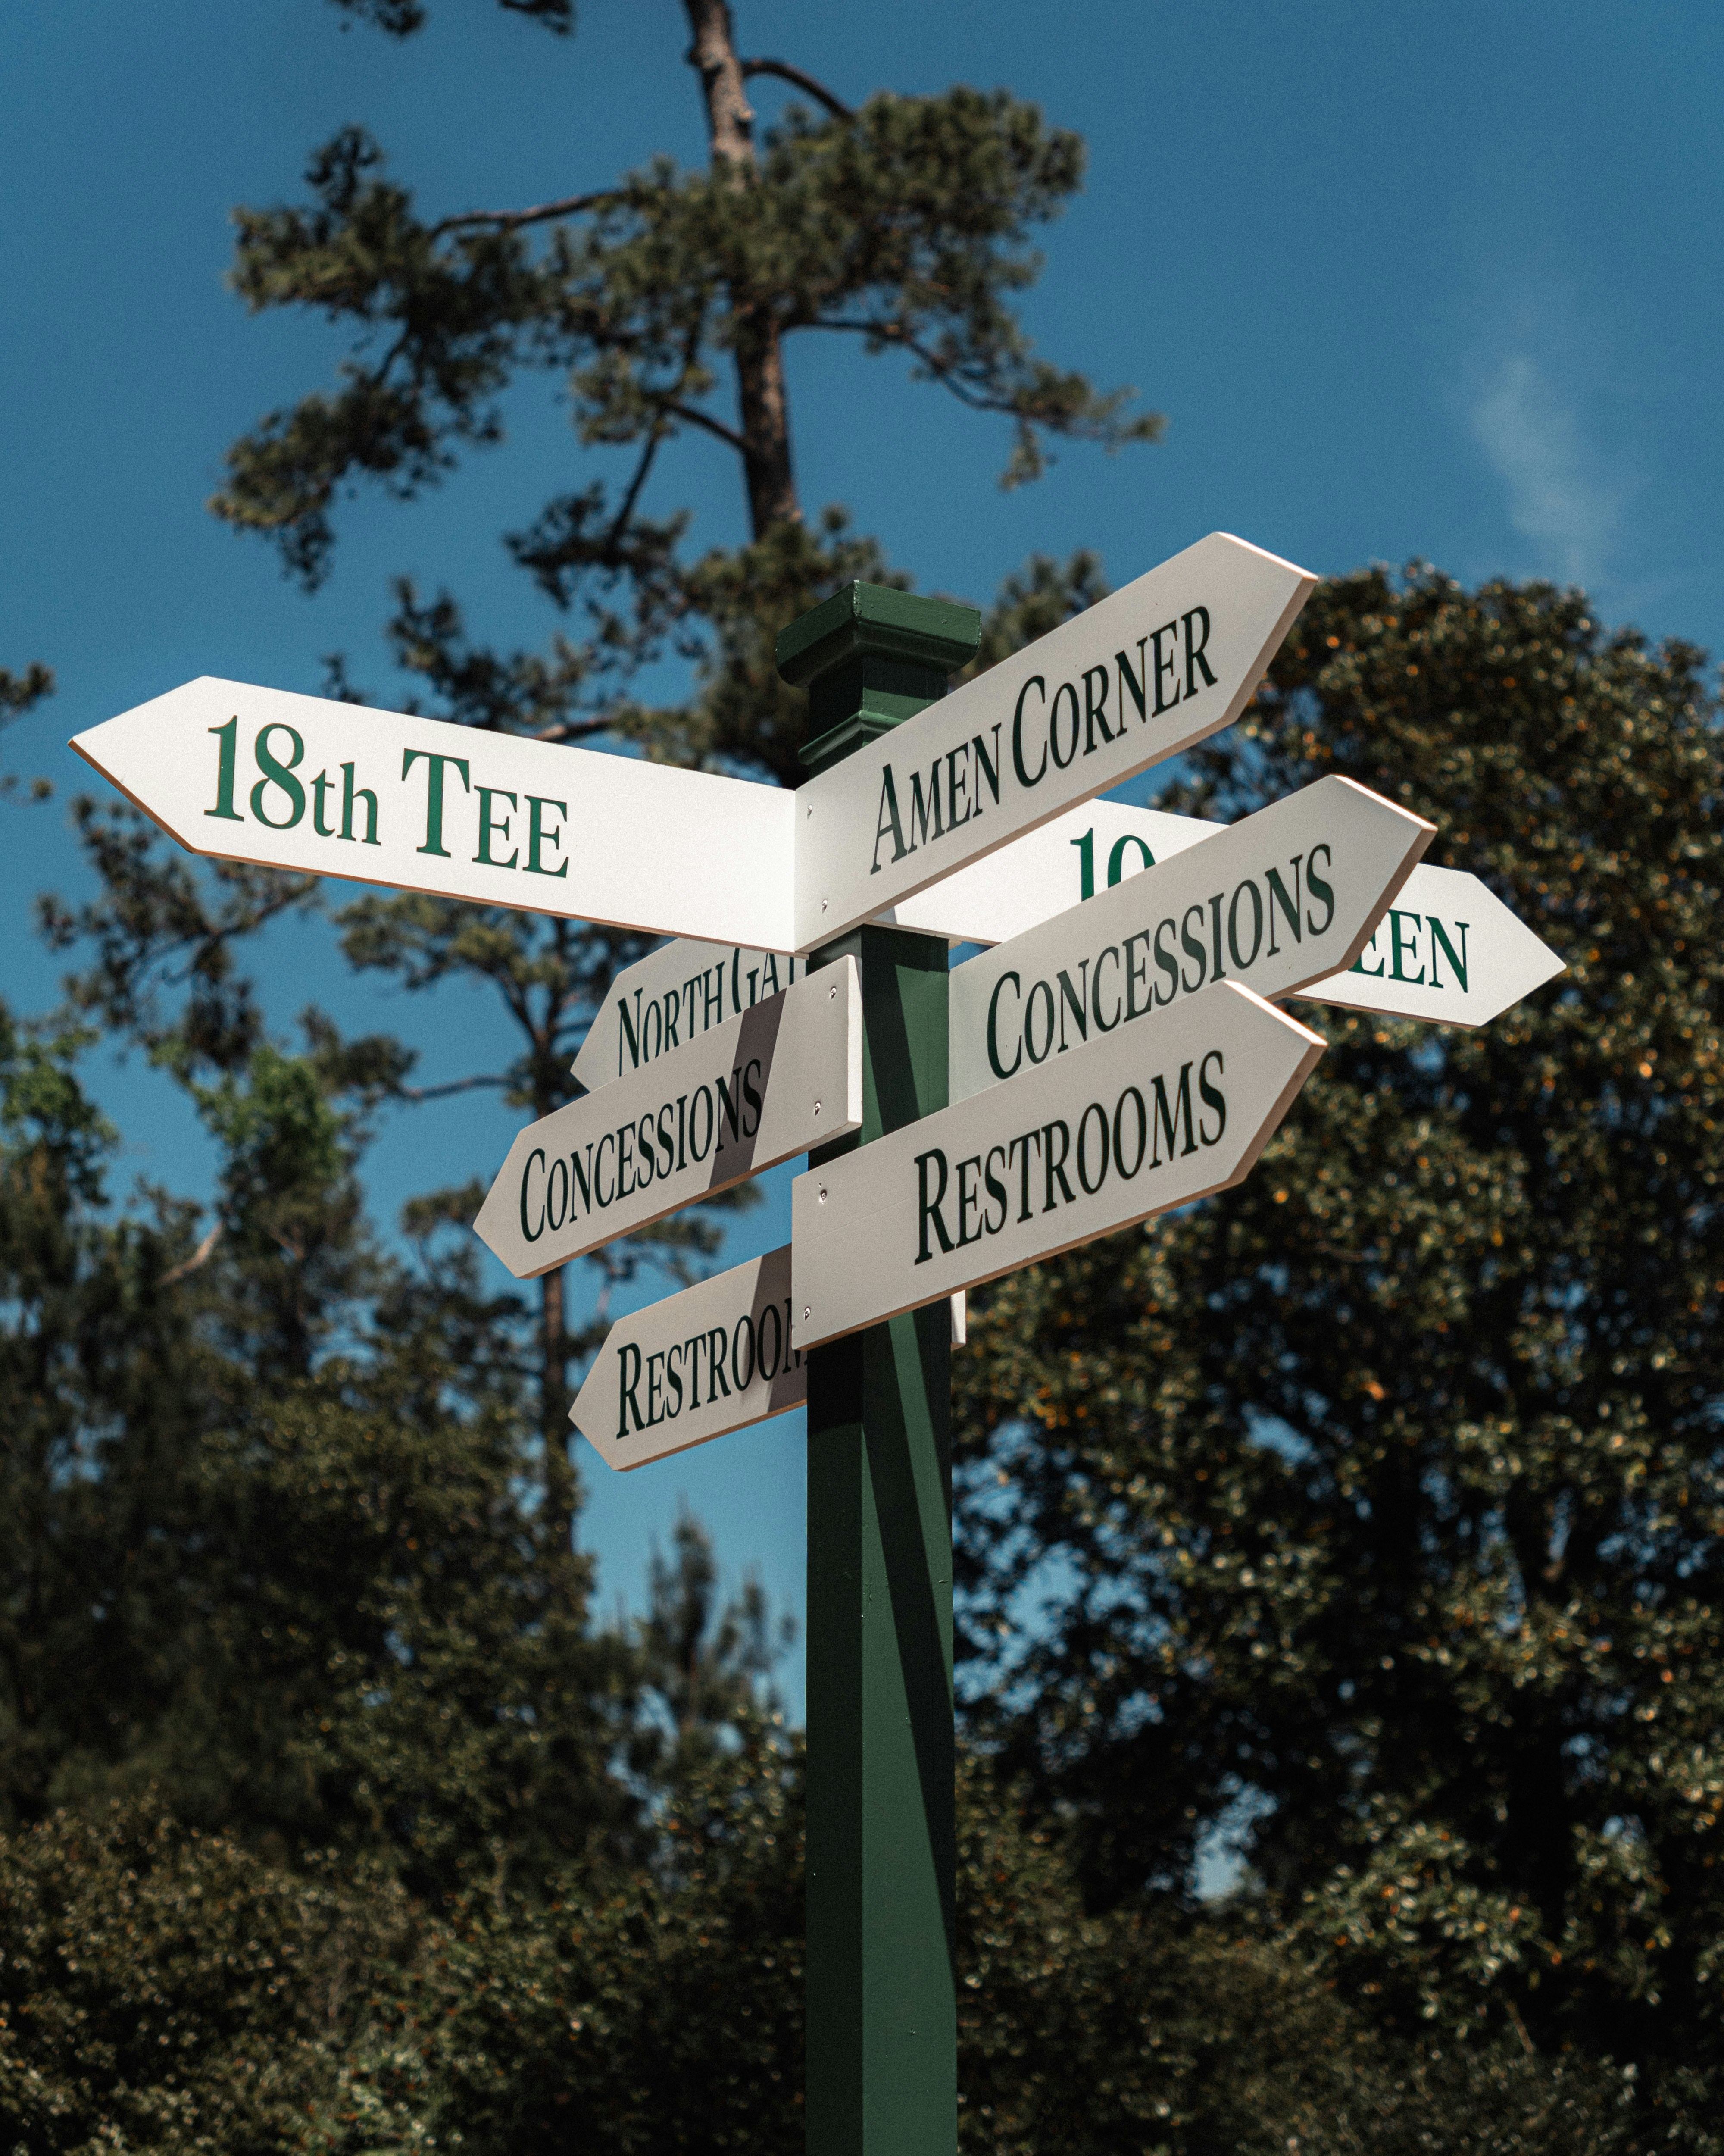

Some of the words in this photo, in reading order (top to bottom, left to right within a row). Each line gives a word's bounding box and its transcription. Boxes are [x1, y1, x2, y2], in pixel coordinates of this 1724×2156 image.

[203, 714, 381, 846] 18th
[401, 748, 569, 879] TEE
[871, 722, 1002, 876] AMEN
[1012, 606, 1218, 788] CORNER
[617, 961, 725, 1077] NORTH
[987, 843, 1335, 1080] CONCESSIONS
[520, 1058, 763, 1243] CONCESSIONS
[913, 1050, 1227, 1266] RESTROOMS
